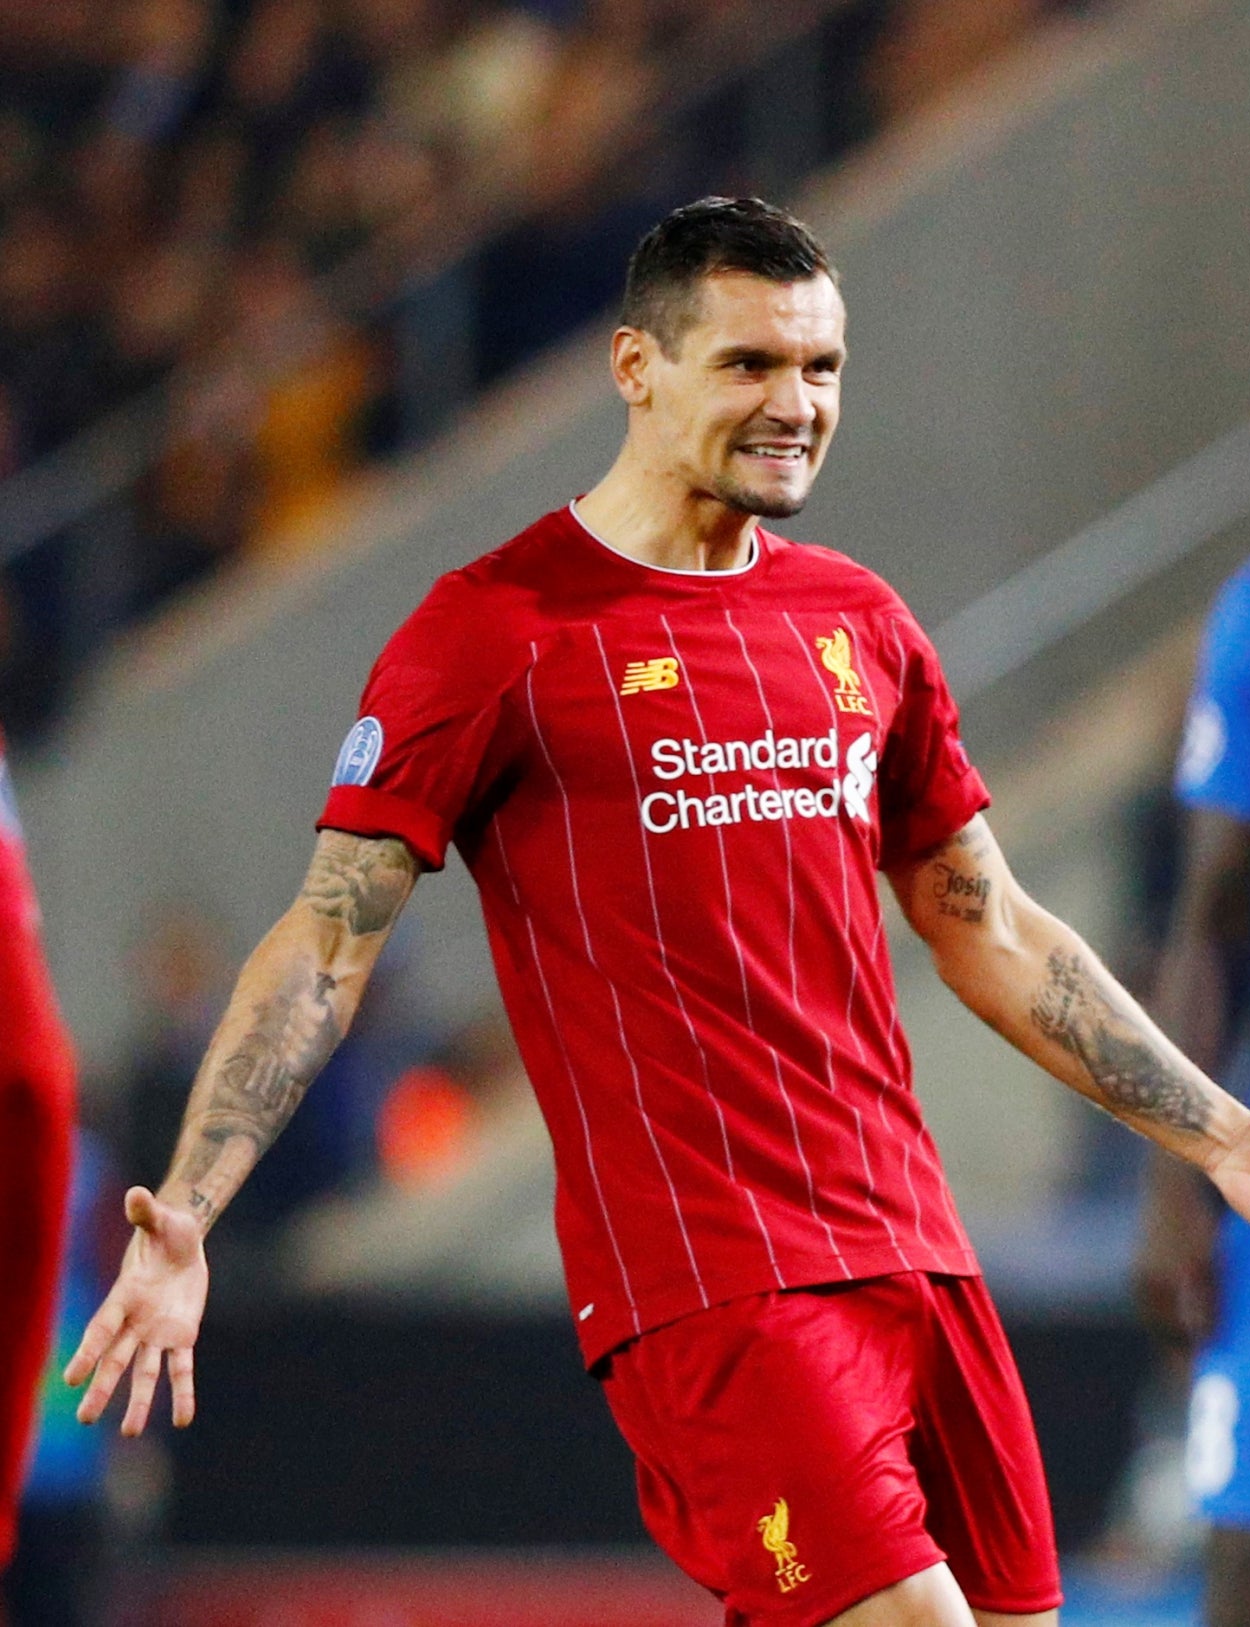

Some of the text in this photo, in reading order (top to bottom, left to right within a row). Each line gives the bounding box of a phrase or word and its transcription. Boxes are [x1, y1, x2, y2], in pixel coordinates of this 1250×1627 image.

[651, 728, 838, 779] Standard
[641, 778, 842, 834] Chartered
[933, 862, 991, 906] Josip
